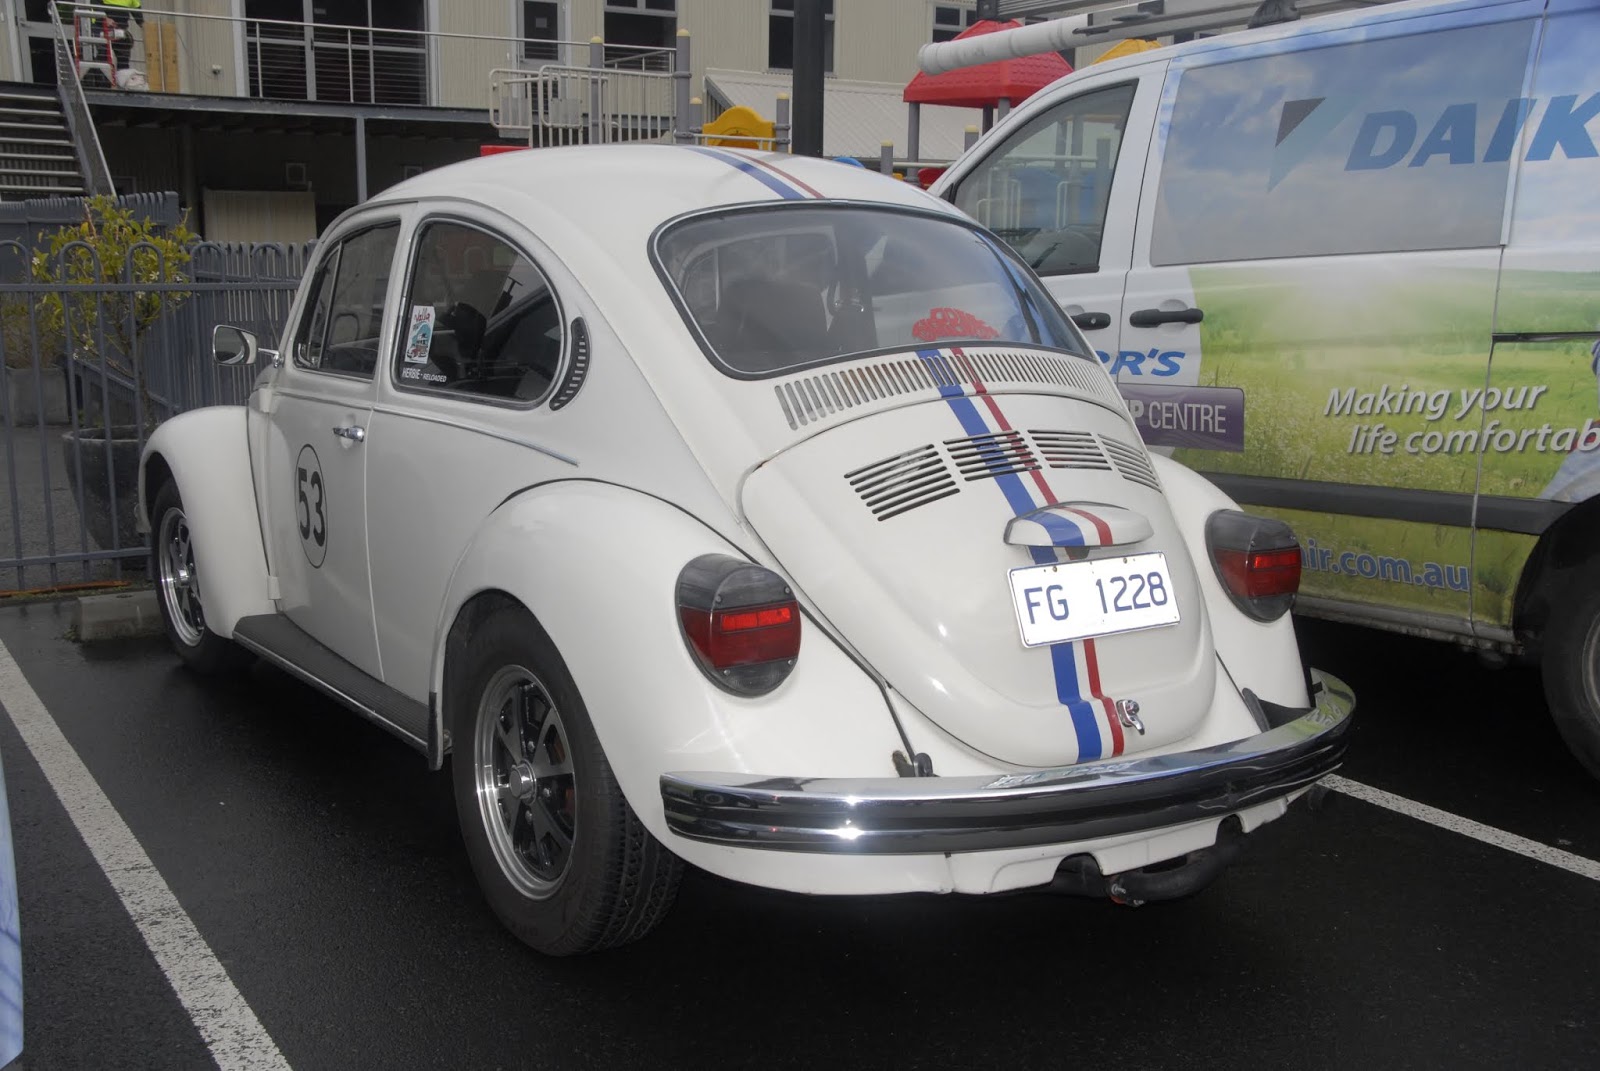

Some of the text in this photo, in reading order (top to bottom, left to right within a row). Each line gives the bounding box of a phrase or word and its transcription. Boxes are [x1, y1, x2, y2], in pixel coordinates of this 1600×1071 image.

[1344, 91, 1600, 172] DAIK
[402, 367, 421, 380] HERBIE
[423, 373, 448, 383] RELOADED
[1148, 401, 1227, 434] CENTRE
[1323, 383, 1548, 421] Making your
[1347, 417, 1600, 454] life comfortab
[298, 466, 326, 548] 53
[1024, 571, 1168, 625] FG 1228
